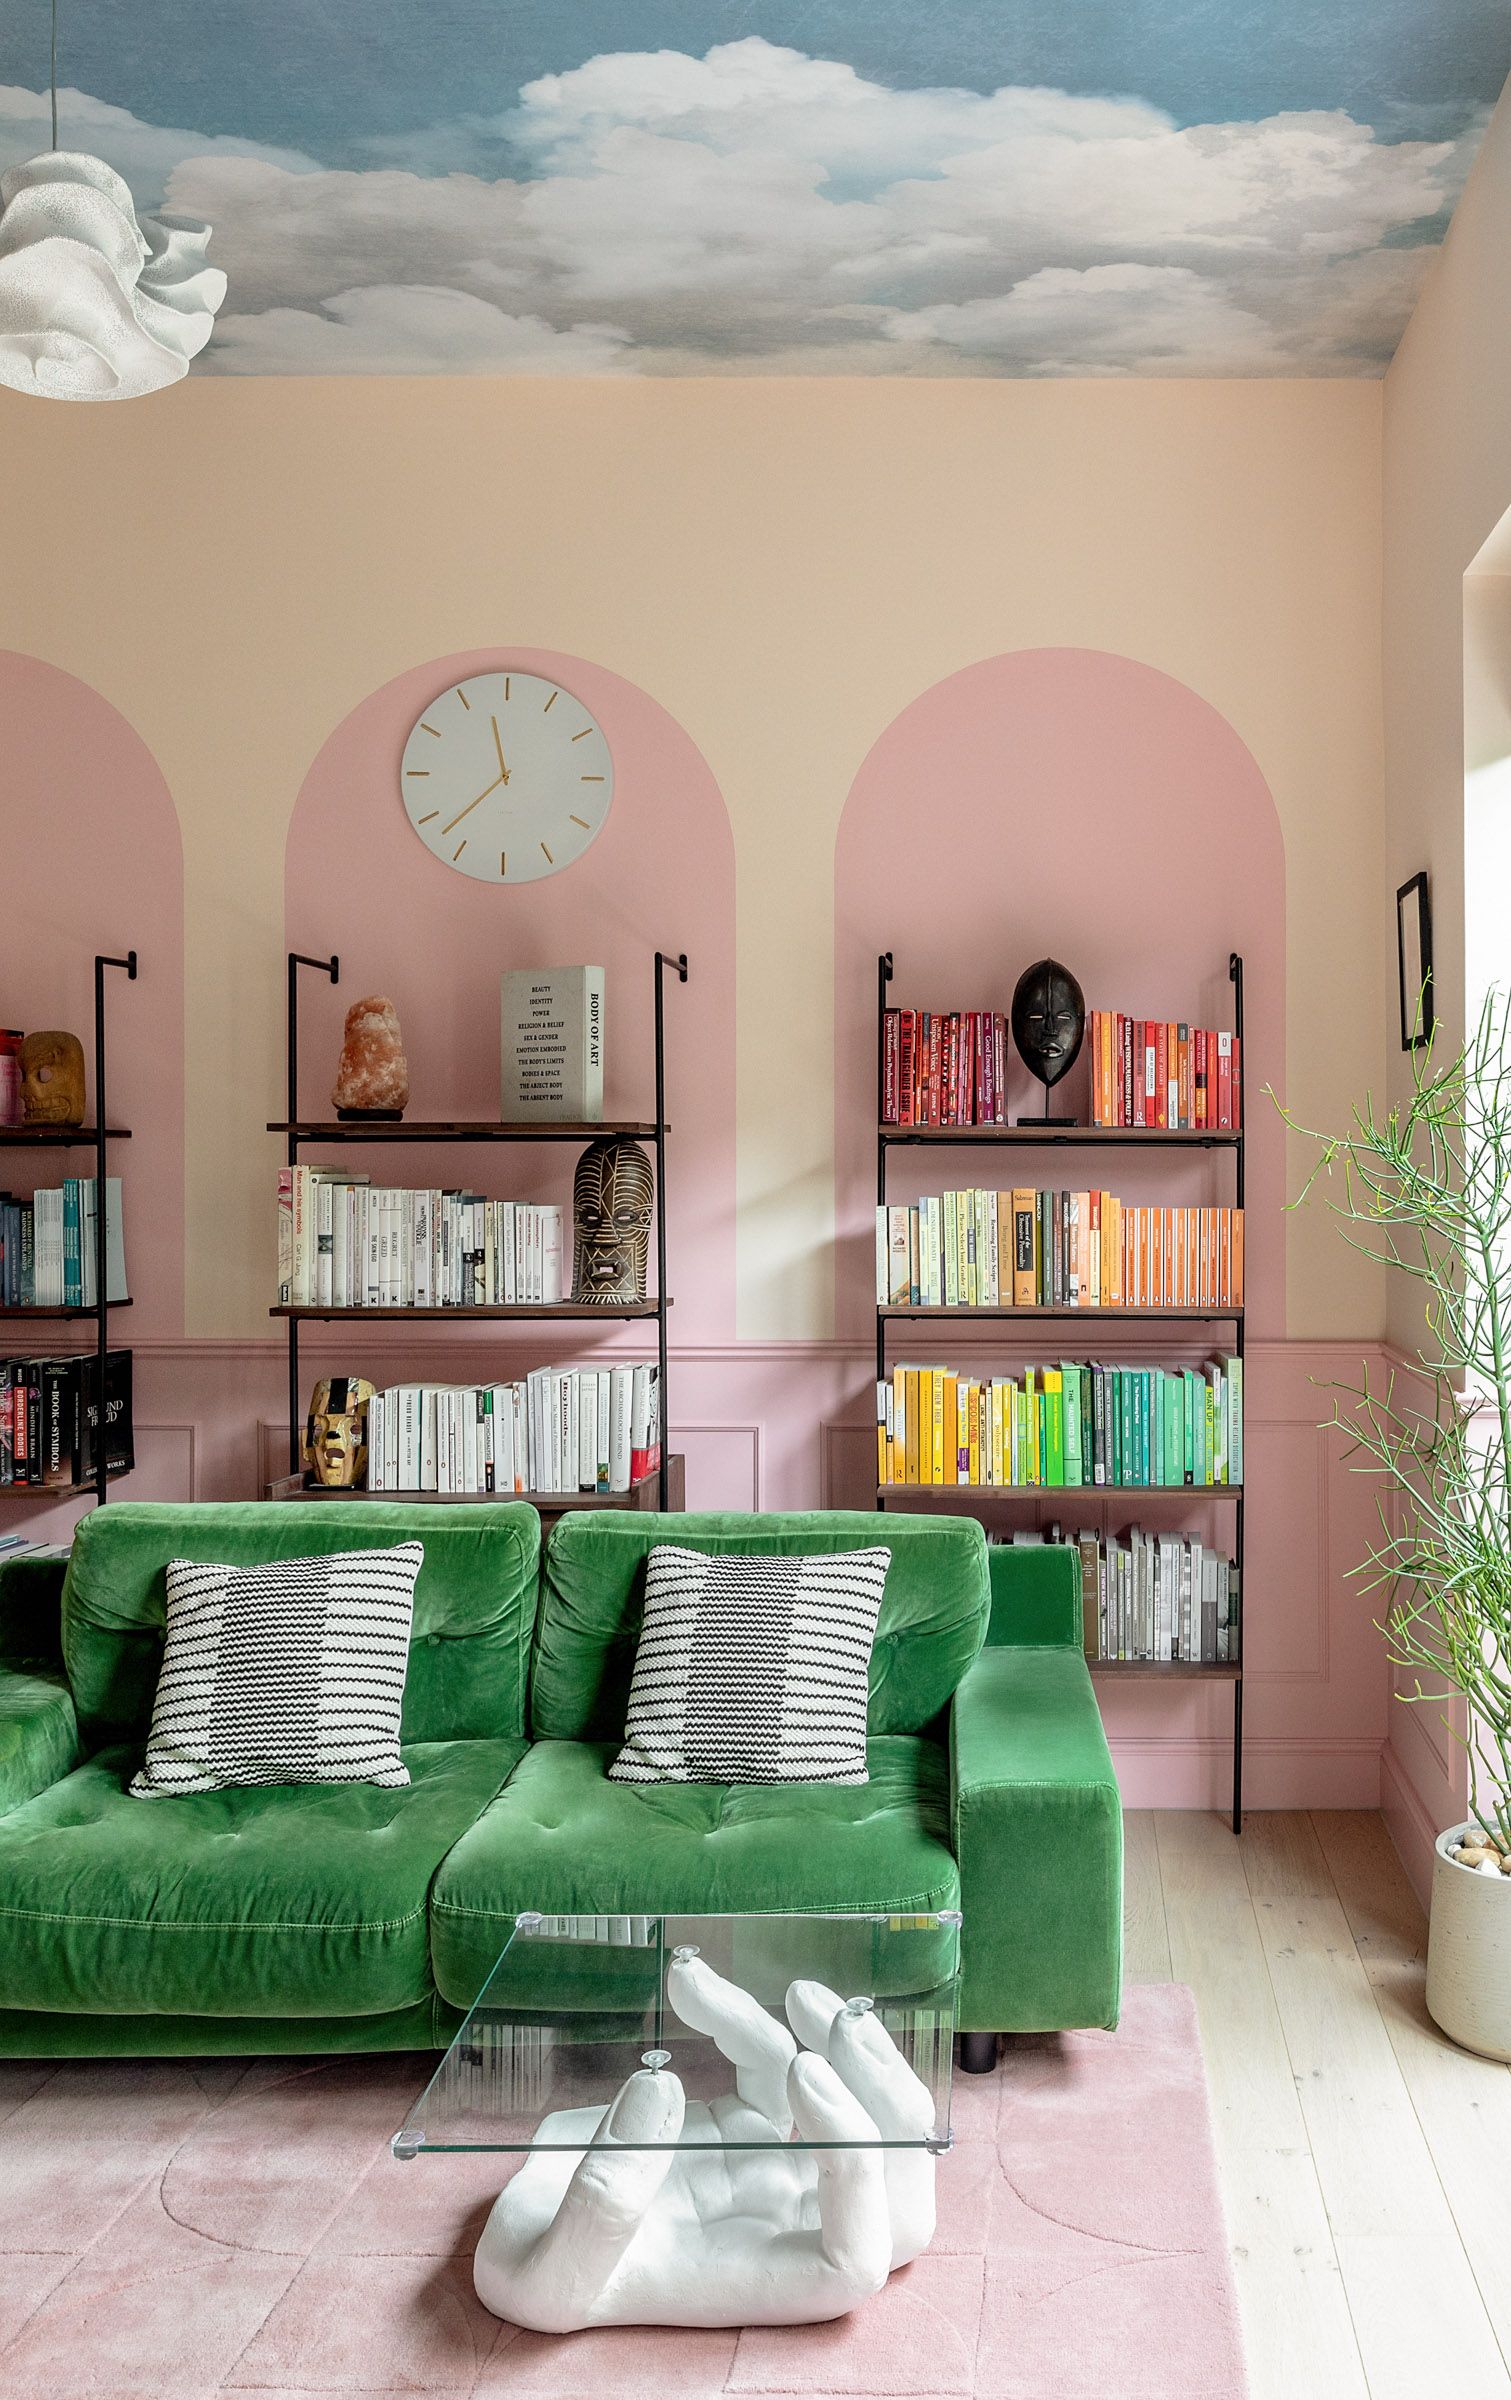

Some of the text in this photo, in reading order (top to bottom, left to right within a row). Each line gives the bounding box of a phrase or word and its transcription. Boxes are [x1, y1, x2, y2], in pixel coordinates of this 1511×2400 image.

[591, 993, 599, 1066] BODY OF ART
[930, 1019, 938, 1052] Unspoken
[902, 1028, 912, 1112] THE TRANSGENDER ISSUE
[930, 1053, 938, 1071] Voice
[87, 1400, 123, 1417] SIGND
[1207, 1412, 1212, 1422] UP
[107, 1460, 125, 1469] WORKS
